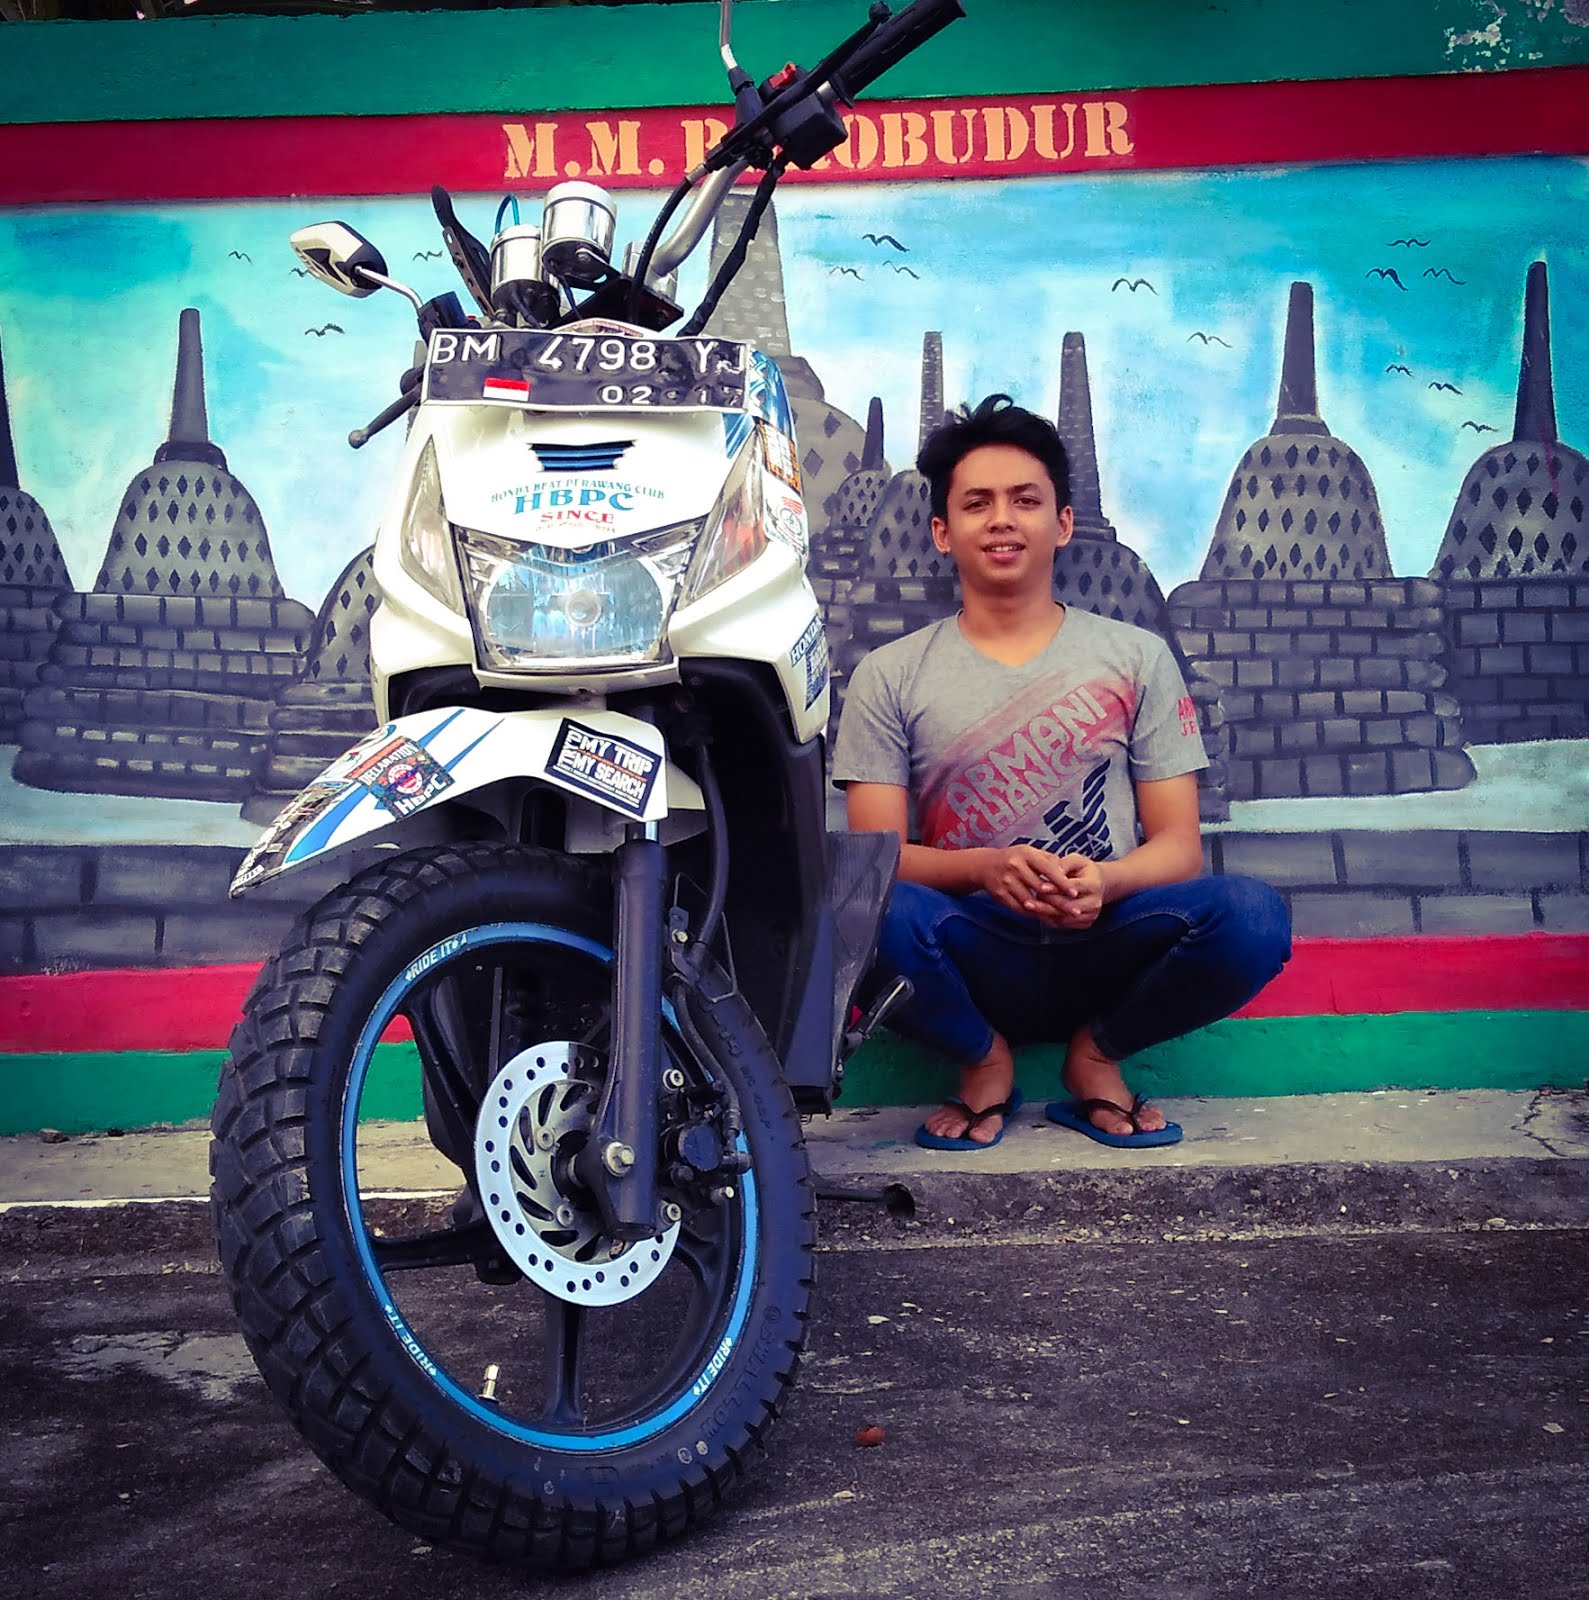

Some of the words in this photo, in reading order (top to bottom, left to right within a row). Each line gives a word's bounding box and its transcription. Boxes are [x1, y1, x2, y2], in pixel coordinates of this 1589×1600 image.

[502, 120, 665, 178] M.M.
[681, 101, 1135, 174] BOBUDUR
[432, 334, 498, 364] BM
[539, 336, 656, 370] 4798
[601, 386, 653, 405] 02
[514, 488, 635, 514] HBPC
[540, 509, 615, 524] SINCE
[579, 735, 613, 758] MY
[613, 744, 654, 776] TRIP
[946, 686, 1107, 822] ARMANI
[571, 750, 597, 775] MY
[593, 761, 647, 800] SEARCH
[393, 773, 448, 816] HBPC
[410, 949, 439, 979] RIDE
[440, 940, 453, 959] IT
[387, 1314, 405, 1330] IT
[400, 1333, 433, 1371] RIDE
[706, 1341, 733, 1378] RIDE
[696, 1376, 712, 1394] IT
